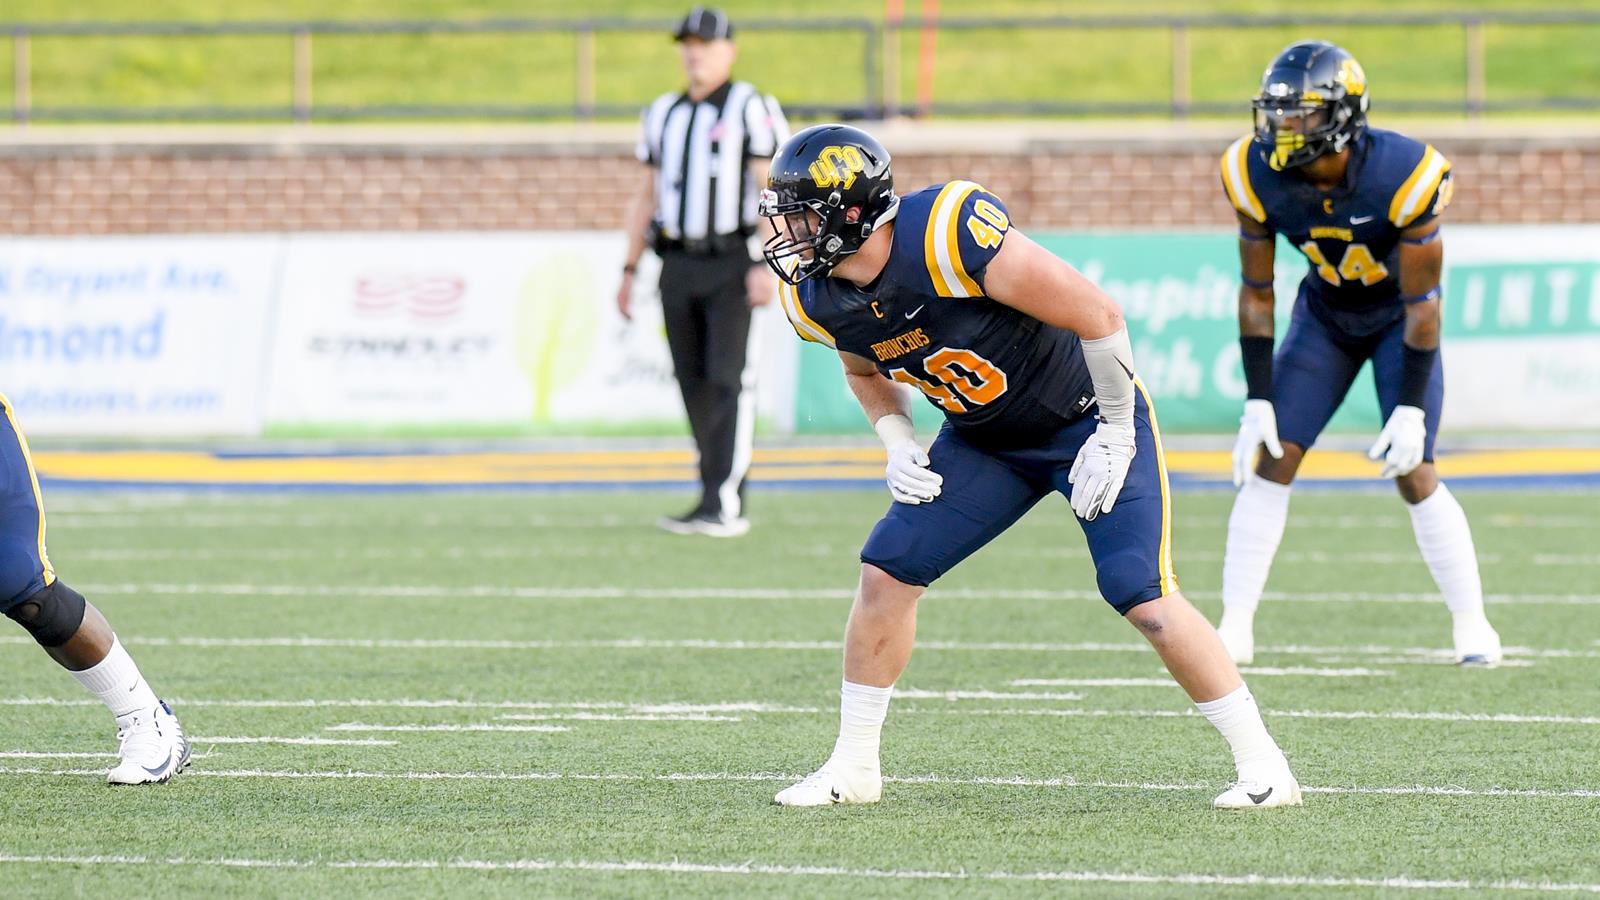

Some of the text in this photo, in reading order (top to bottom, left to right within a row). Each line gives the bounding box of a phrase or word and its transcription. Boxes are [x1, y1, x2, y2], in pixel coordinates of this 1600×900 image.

[808, 145, 865, 190] UCO
[966, 198, 1010, 250] 40
[1299, 241, 1389, 288] 14
[870, 300, 884, 319] C
[870, 327, 930, 362] BRONCHOS
